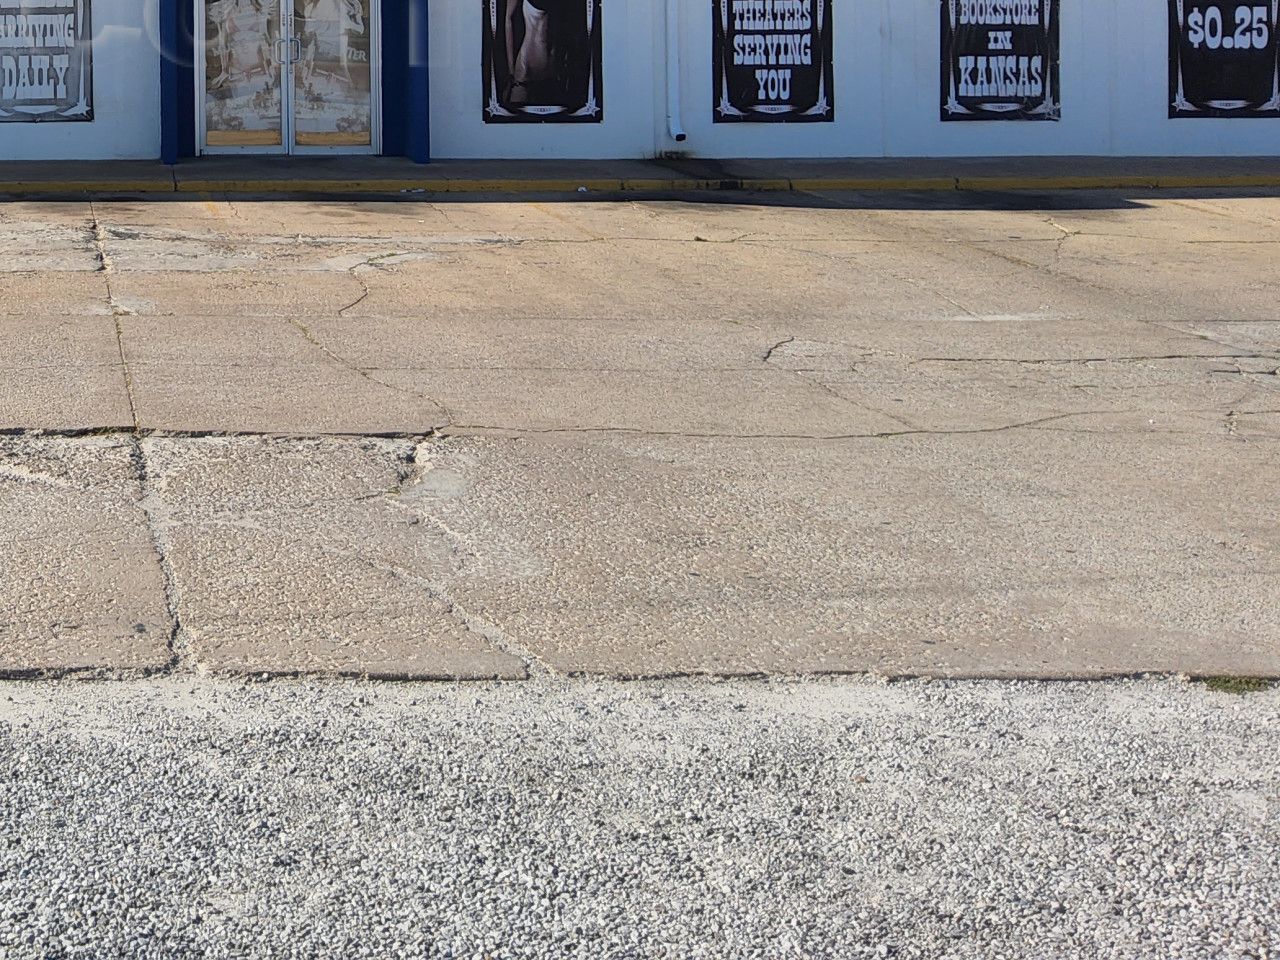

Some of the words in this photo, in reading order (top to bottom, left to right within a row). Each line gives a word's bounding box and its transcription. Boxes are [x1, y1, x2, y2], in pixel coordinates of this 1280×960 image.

[732, 0, 812, 31] THEATERS
[1188, 6, 1269, 49] $0.25
[733, 34, 812, 65] SERVING
[988, 30, 1012, 50] IN
[2, 54, 69, 99] DAILY
[755, 69, 792, 100] YOU
[958, 55, 1043, 97] KANSAS
